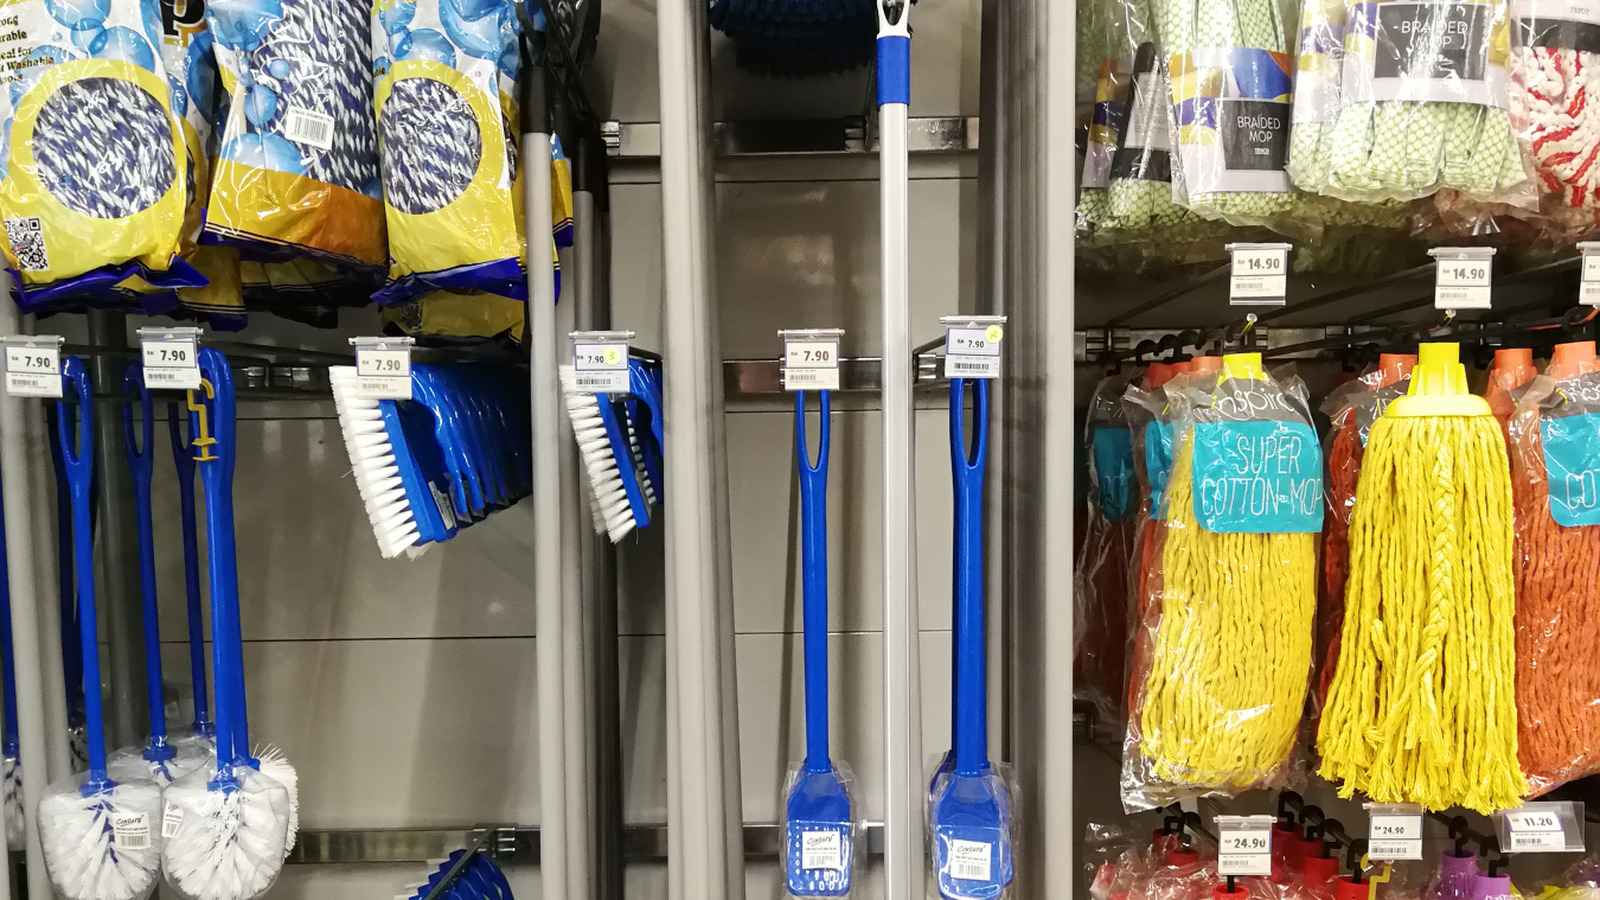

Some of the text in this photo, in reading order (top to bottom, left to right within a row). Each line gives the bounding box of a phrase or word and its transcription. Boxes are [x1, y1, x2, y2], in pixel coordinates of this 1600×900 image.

[0, 15, 19, 26] ong
[0, 29, 28, 42] rable
[1237, 113, 1281, 130] BRAIDED
[1249, 130, 1273, 143] MOP
[1248, 257, 1280, 270] 14.90
[1453, 268, 1485, 280] 14.90
[968, 339, 985, 348] 7.90
[160, 349, 186, 361] 7.90
[587, 355, 604, 364] 7.90
[804, 350, 829, 362] 7.90
[24, 355, 50, 368] 7.90
[375, 359, 401, 371] 7.90
[1231, 435, 1301, 475] SUPER
[1565, 469, 1600, 510] CO
[1202, 477, 1280, 516] COTTON
[1290, 477, 1323, 516] MOP
[1524, 816, 1553, 826] 11.20
[1383, 826, 1404, 835] 24.90
[1234, 837, 1266, 849] 24.90
